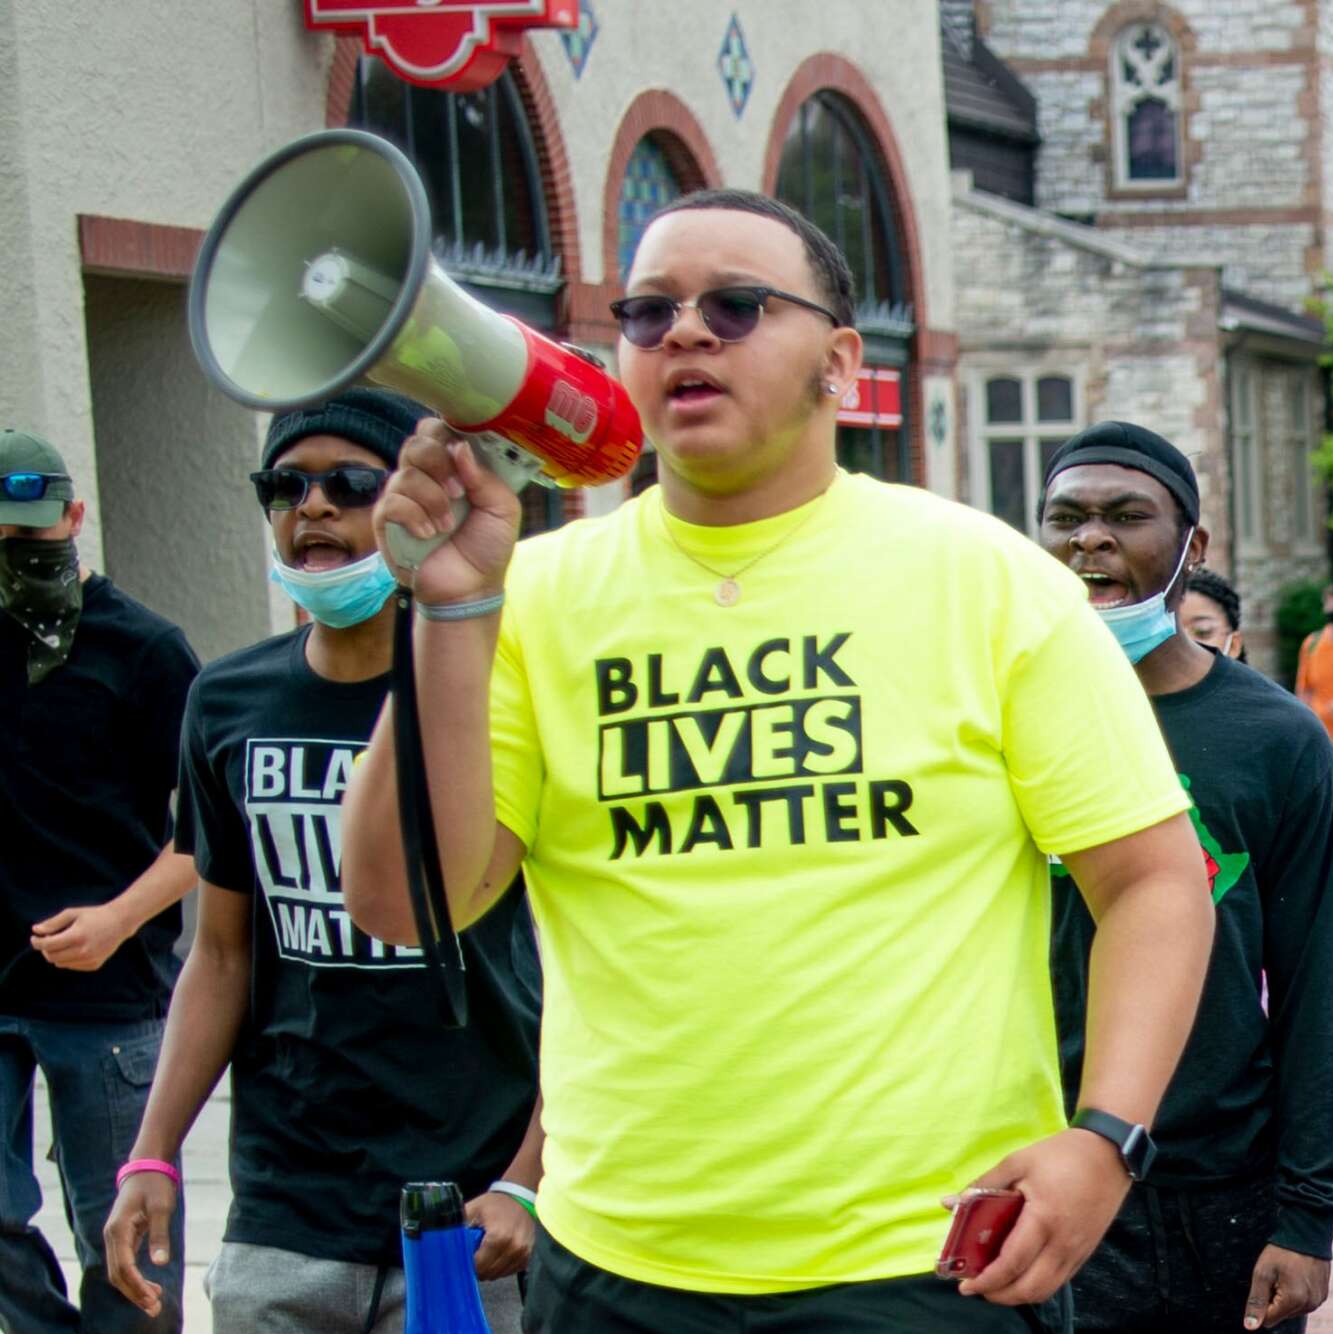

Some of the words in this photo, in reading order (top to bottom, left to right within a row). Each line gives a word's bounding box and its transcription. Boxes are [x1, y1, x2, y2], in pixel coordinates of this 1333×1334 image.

[594, 631, 858, 717] BLACK
[252, 746, 354, 800] BLA
[601, 698, 858, 797] LIVES
[608, 779, 921, 861] MATTER
